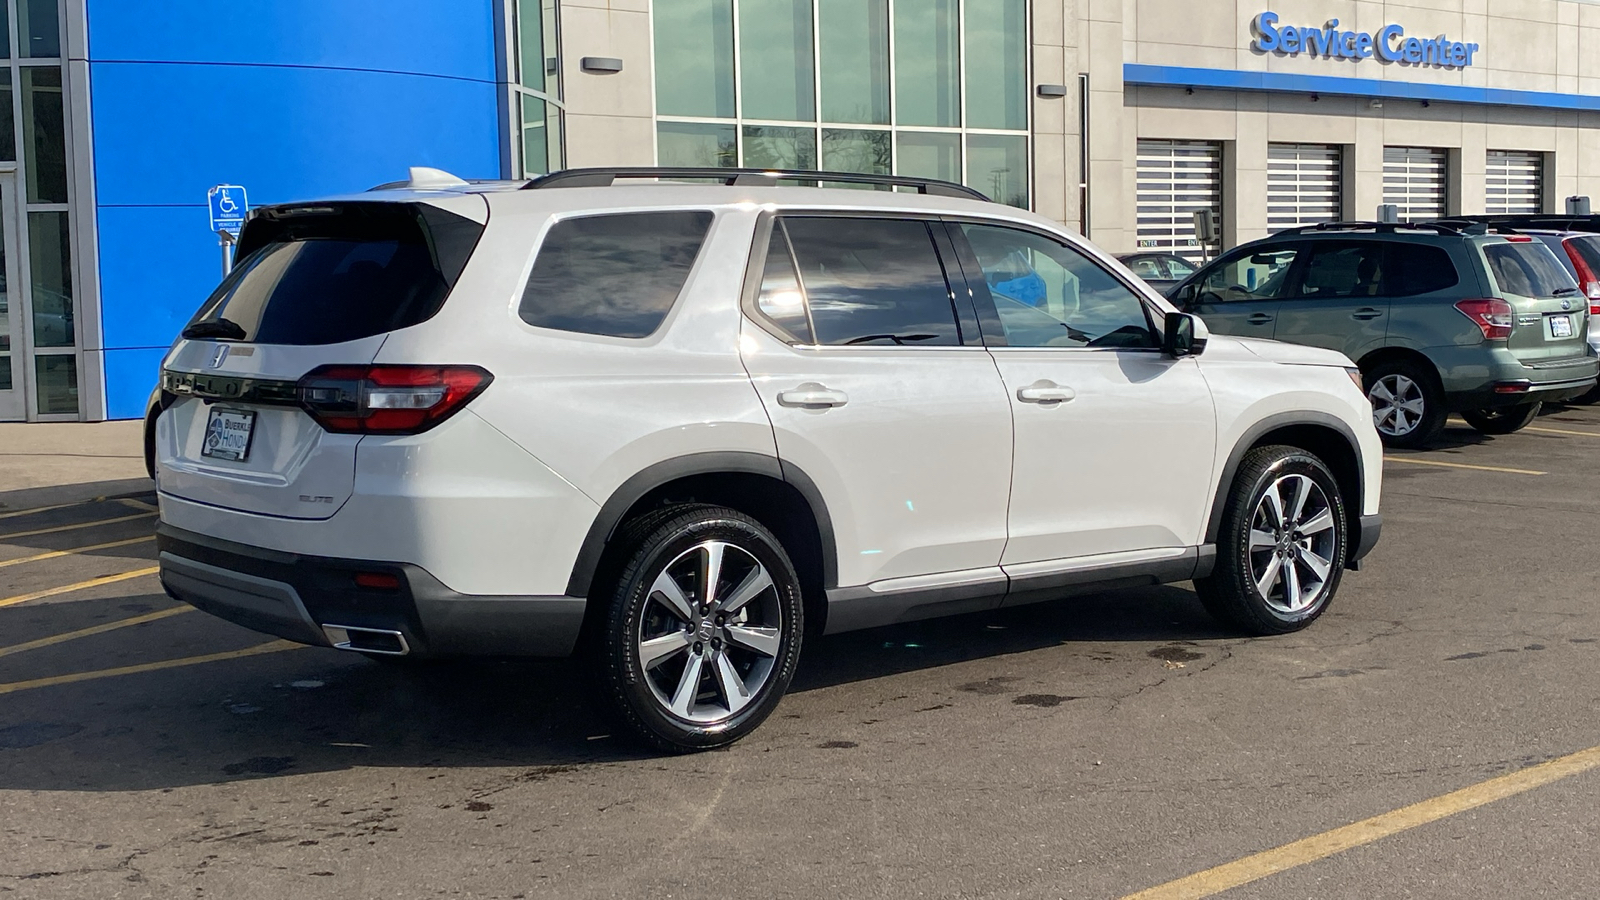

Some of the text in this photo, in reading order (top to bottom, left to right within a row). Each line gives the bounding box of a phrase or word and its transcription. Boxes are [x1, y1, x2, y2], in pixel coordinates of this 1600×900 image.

[1255, 11, 1479, 67] Service Center
[224, 418, 251, 432] BUERKLE
[299, 494, 333, 503] ELITE
